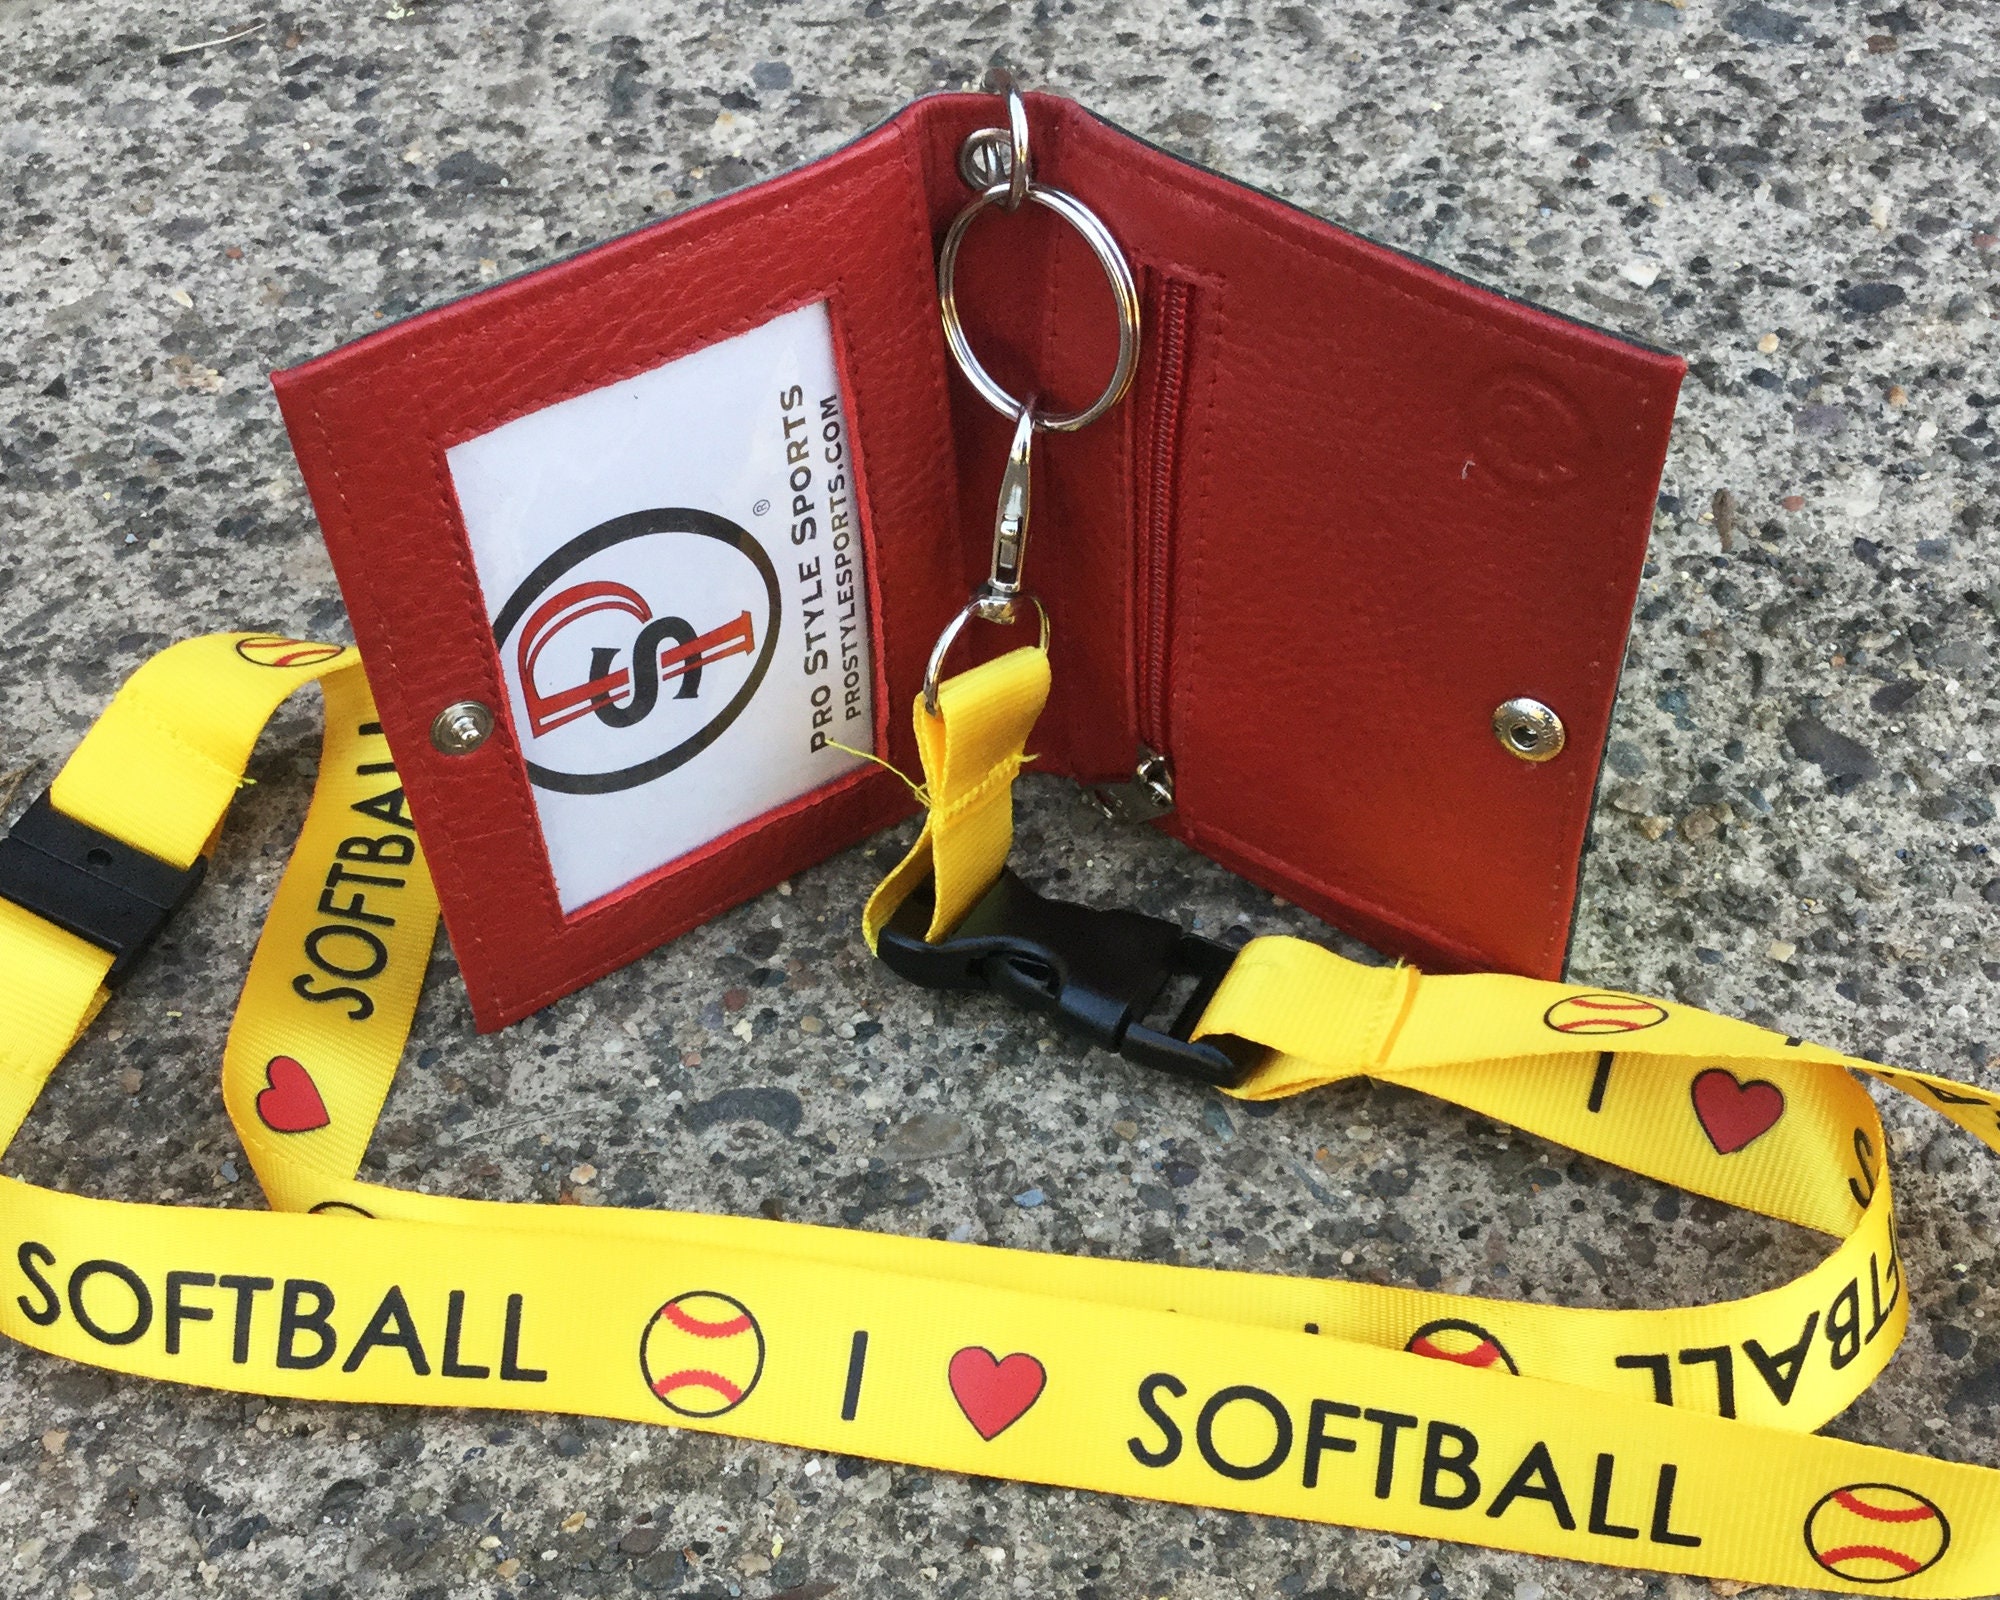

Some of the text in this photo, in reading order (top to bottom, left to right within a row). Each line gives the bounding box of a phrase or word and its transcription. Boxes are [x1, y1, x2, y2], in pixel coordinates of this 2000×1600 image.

[780, 384, 834, 753] PRO STYLE SPORTS
[819, 394, 862, 721] PROSTYLESPORTS.COM
[17, 1241, 1702, 1547] SOFTBALL I SOFTBALL
